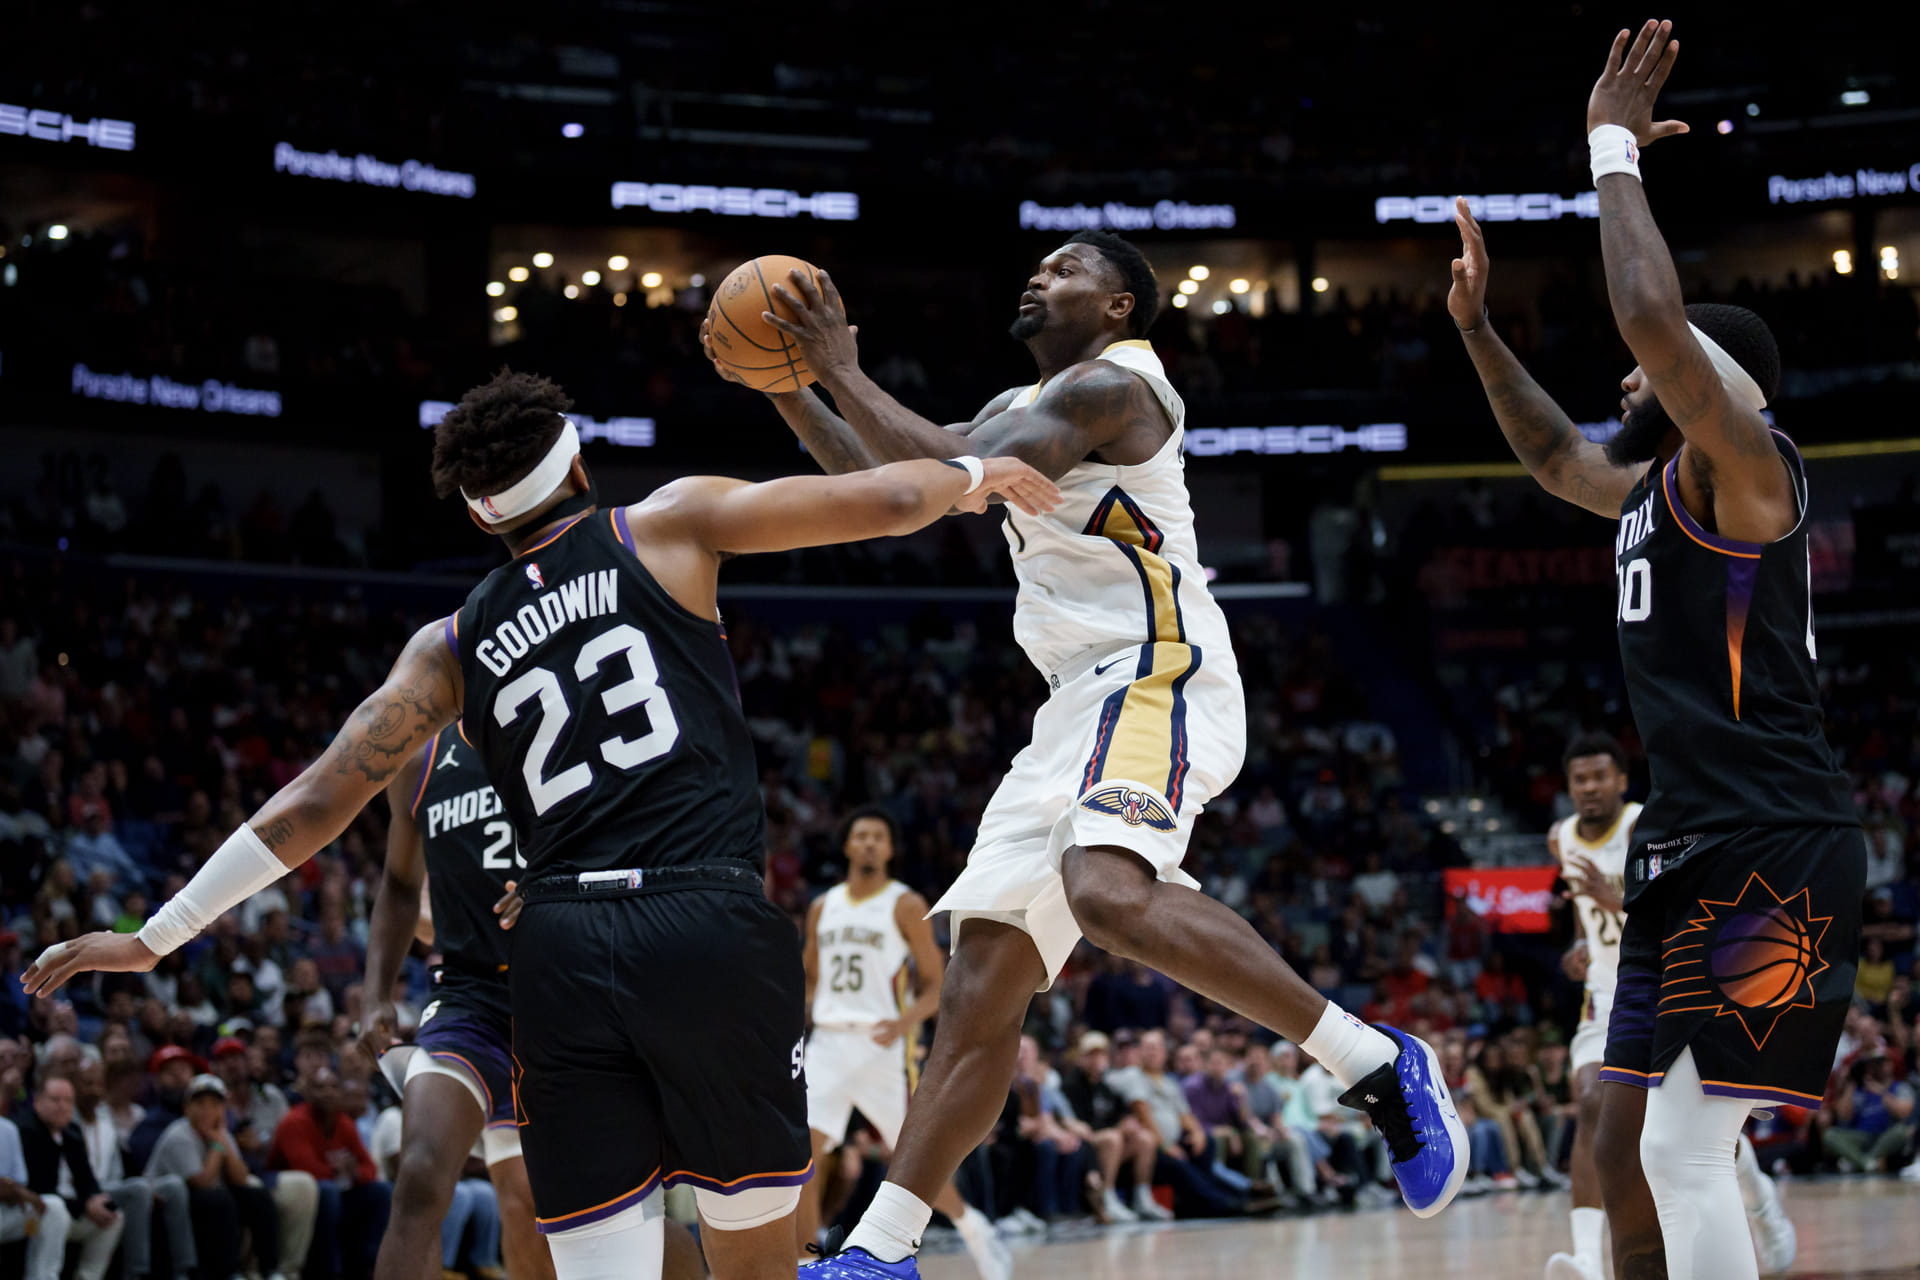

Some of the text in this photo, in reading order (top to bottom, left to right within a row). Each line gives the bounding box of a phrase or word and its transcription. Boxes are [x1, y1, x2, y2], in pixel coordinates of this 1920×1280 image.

[274, 141, 476, 199] Porsche New Orleans
[1768, 171, 1855, 204] Porsche
[1857, 168, 1907, 197] New
[611, 181, 859, 220] PORSCHE
[1019, 199, 1236, 231] Porsche New Orleans
[1375, 191, 1600, 223] PORSCH
[72, 362, 282, 418] Porsche New Orleans
[1184, 423, 1408, 456] ORSCHE
[1617, 558, 1651, 627] 0
[475, 569, 618, 678] GOODWIN
[493, 623, 680, 817] 23
[831, 953, 863, 993] 25
